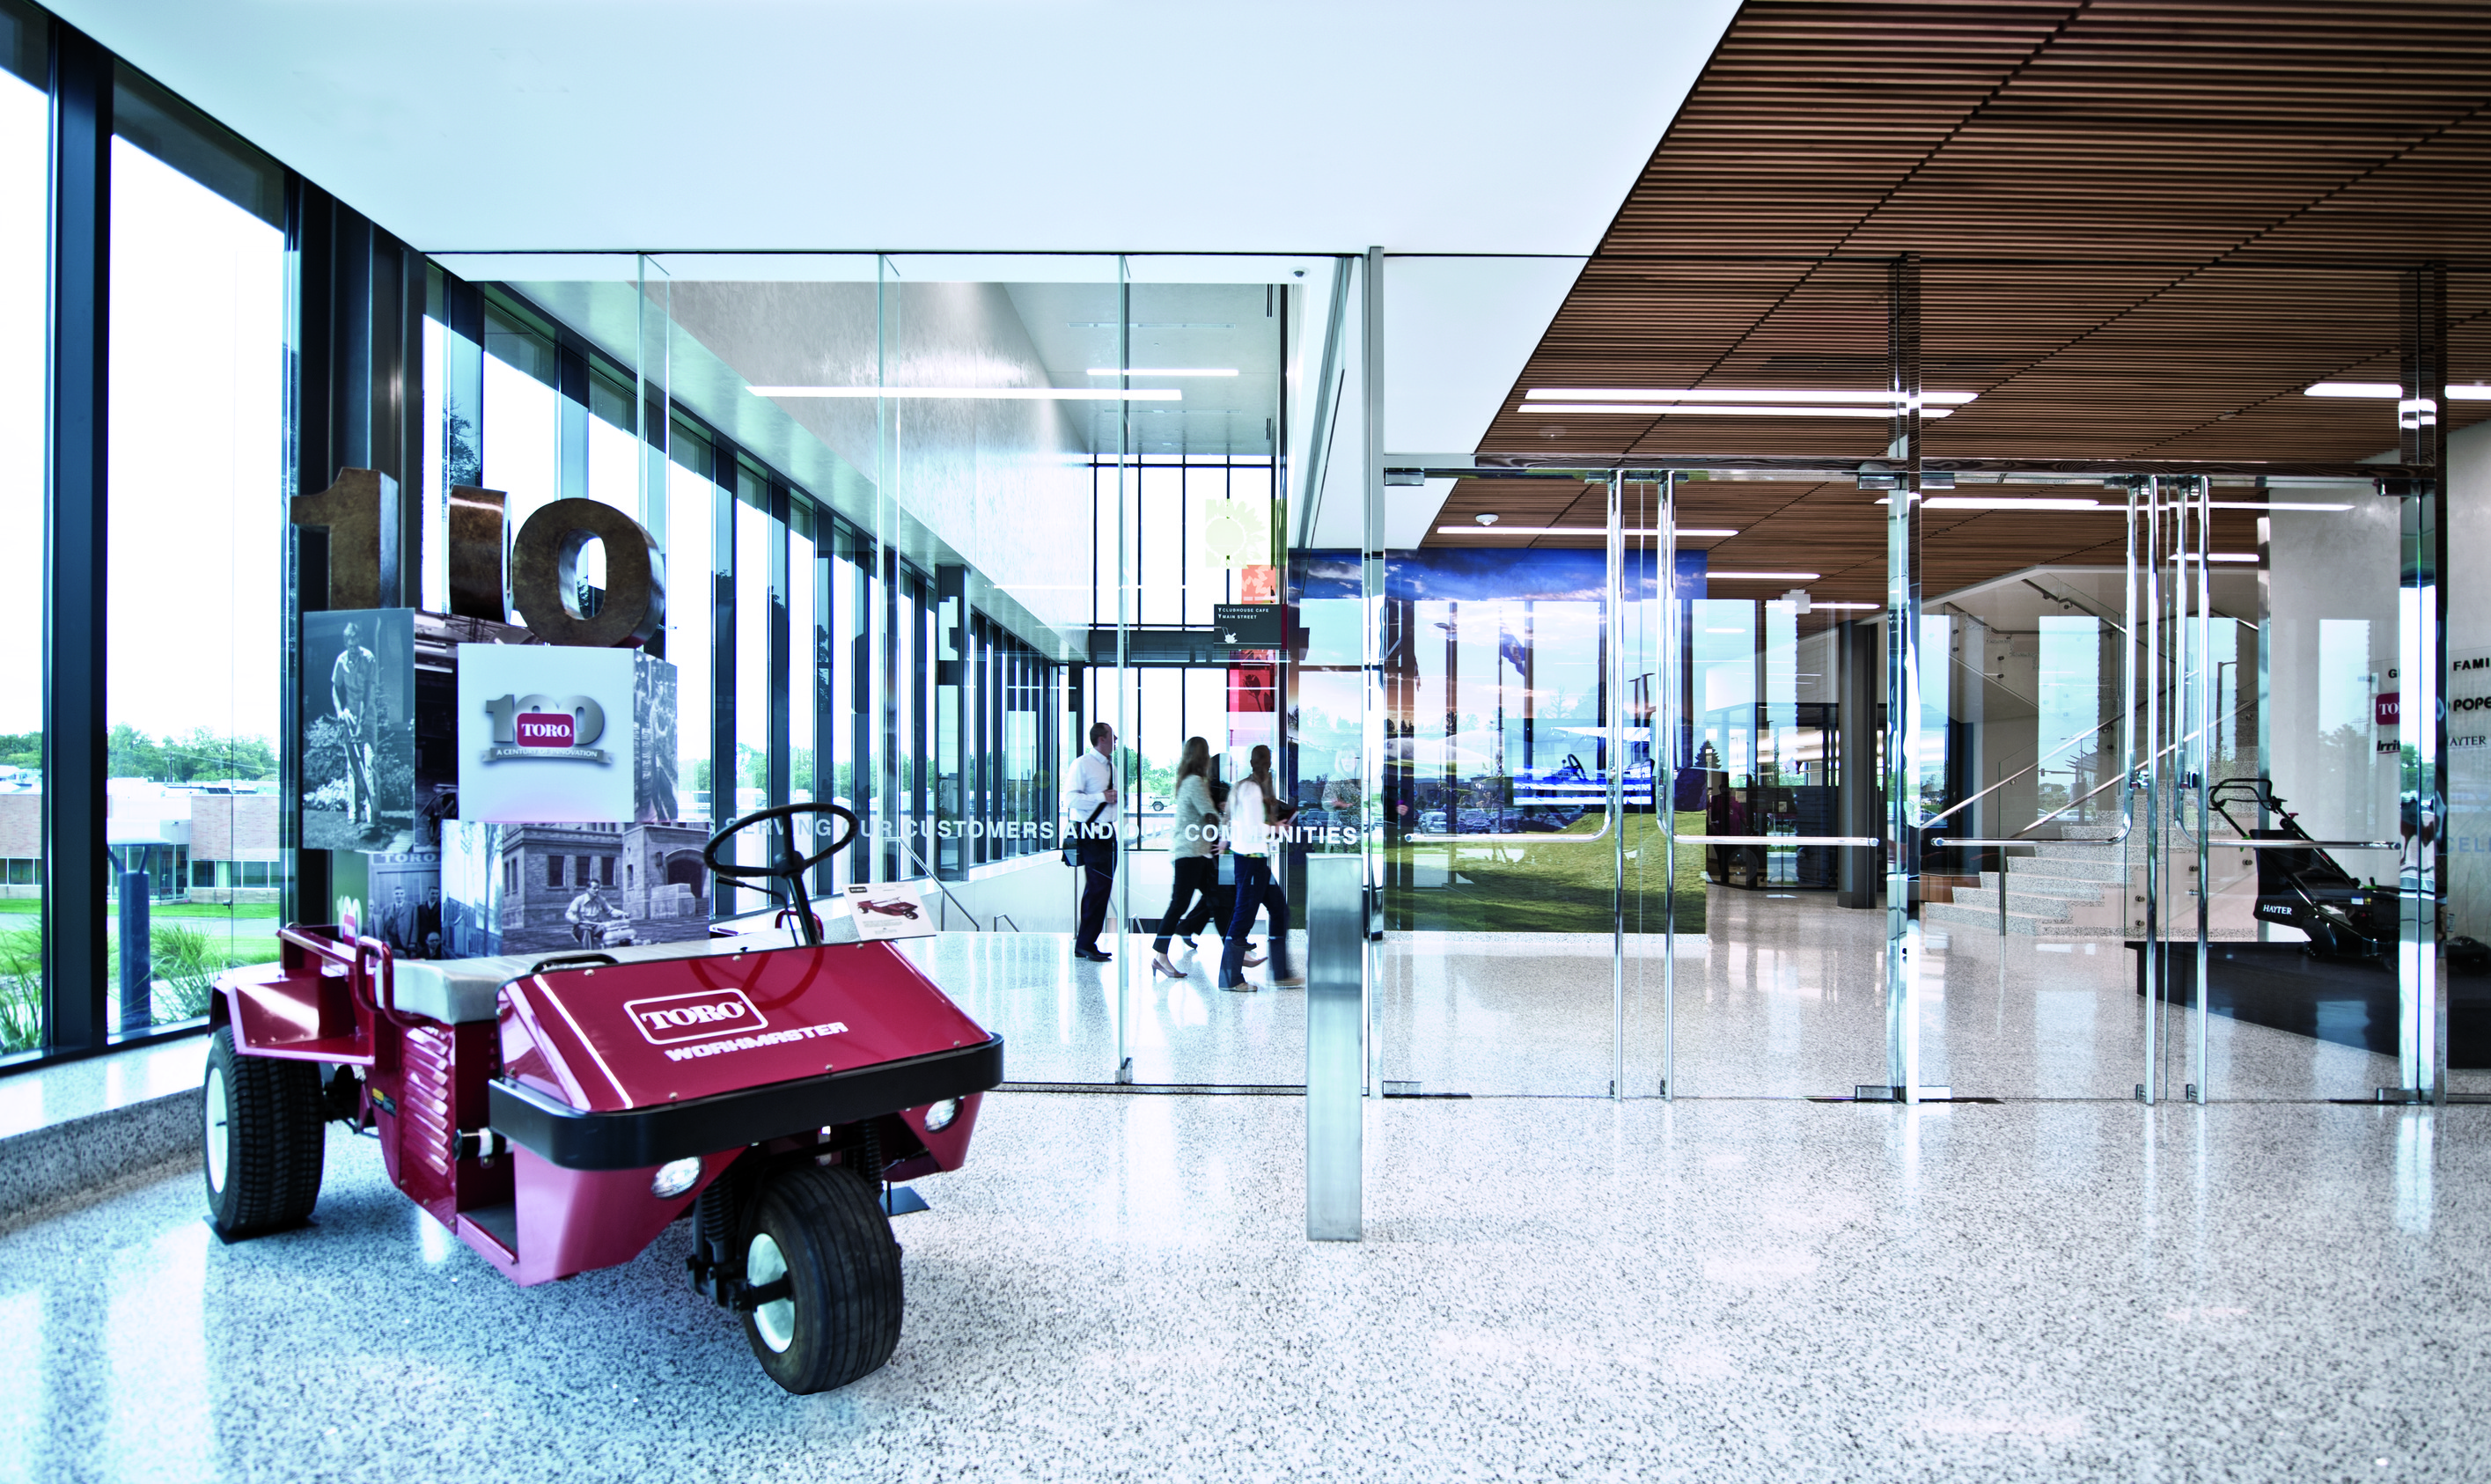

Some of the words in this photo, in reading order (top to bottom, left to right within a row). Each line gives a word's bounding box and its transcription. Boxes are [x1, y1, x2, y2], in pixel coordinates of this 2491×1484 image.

[2378, 702, 2399, 716] TO
[521, 724, 570, 738] TORO
[2450, 735, 2487, 747] AYTER
[550, 748, 598, 758] INNOVATION
[903, 819, 1054, 839] CUSTOMERS
[1064, 822, 1113, 840] AND
[1185, 823, 1357, 845] COMMUNITIES
[381, 853, 437, 863] TORO
[2263, 904, 2292, 915] HAYTER
[640, 1002, 745, 1030] TORO
[664, 1021, 849, 1062] WORKMASTER
